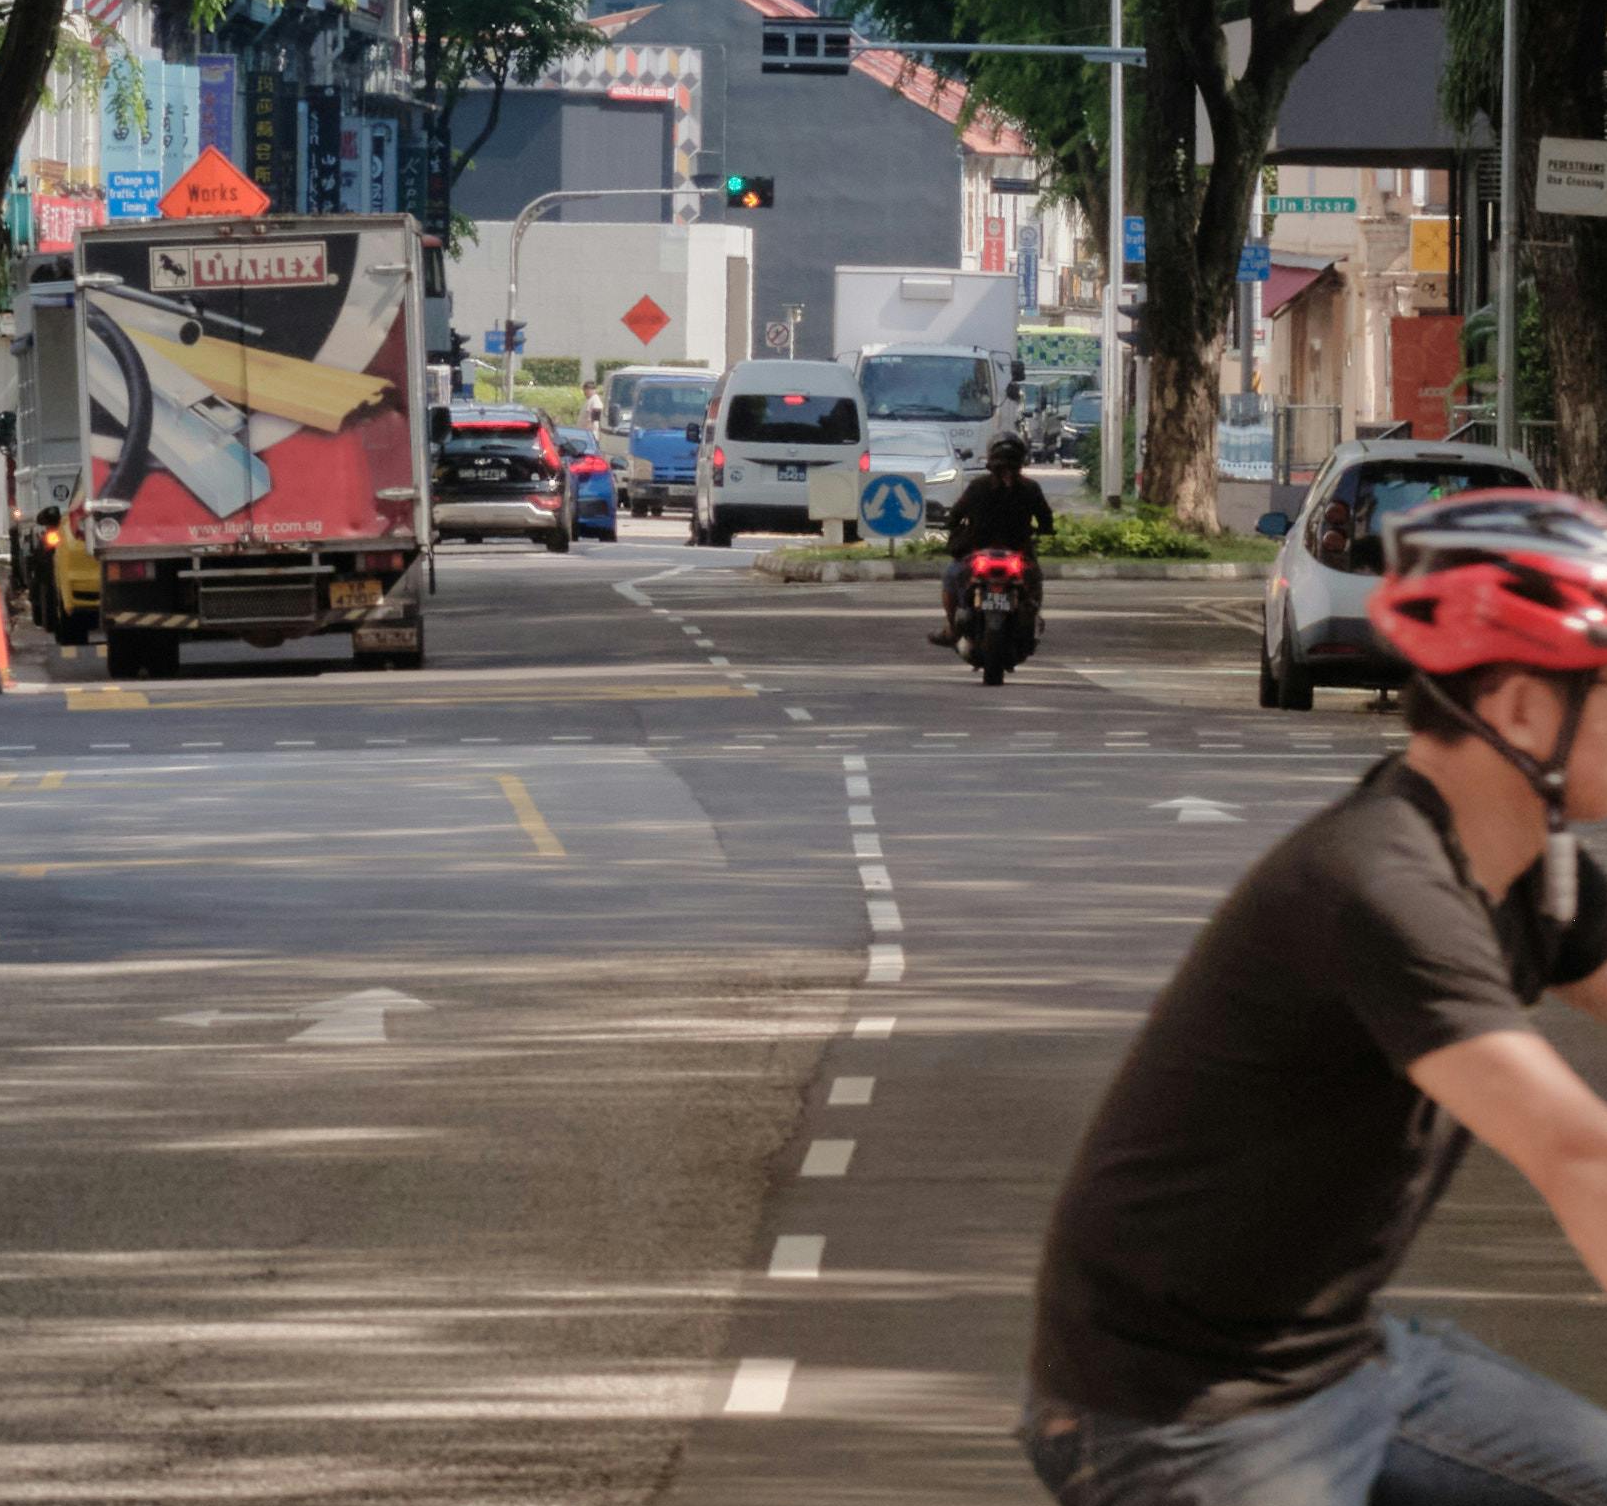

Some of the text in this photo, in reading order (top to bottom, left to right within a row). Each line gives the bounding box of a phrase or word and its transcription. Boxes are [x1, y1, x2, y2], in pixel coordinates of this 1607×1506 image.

[1547, 159, 1606, 172] PEDESTRIANS
[1546, 174, 1605, 190] Use Crossing
[187, 184, 238, 202] Works
[1303, 199, 1350, 211] Besar
[188, 519, 323, 537] www.litaflex.com.sg
